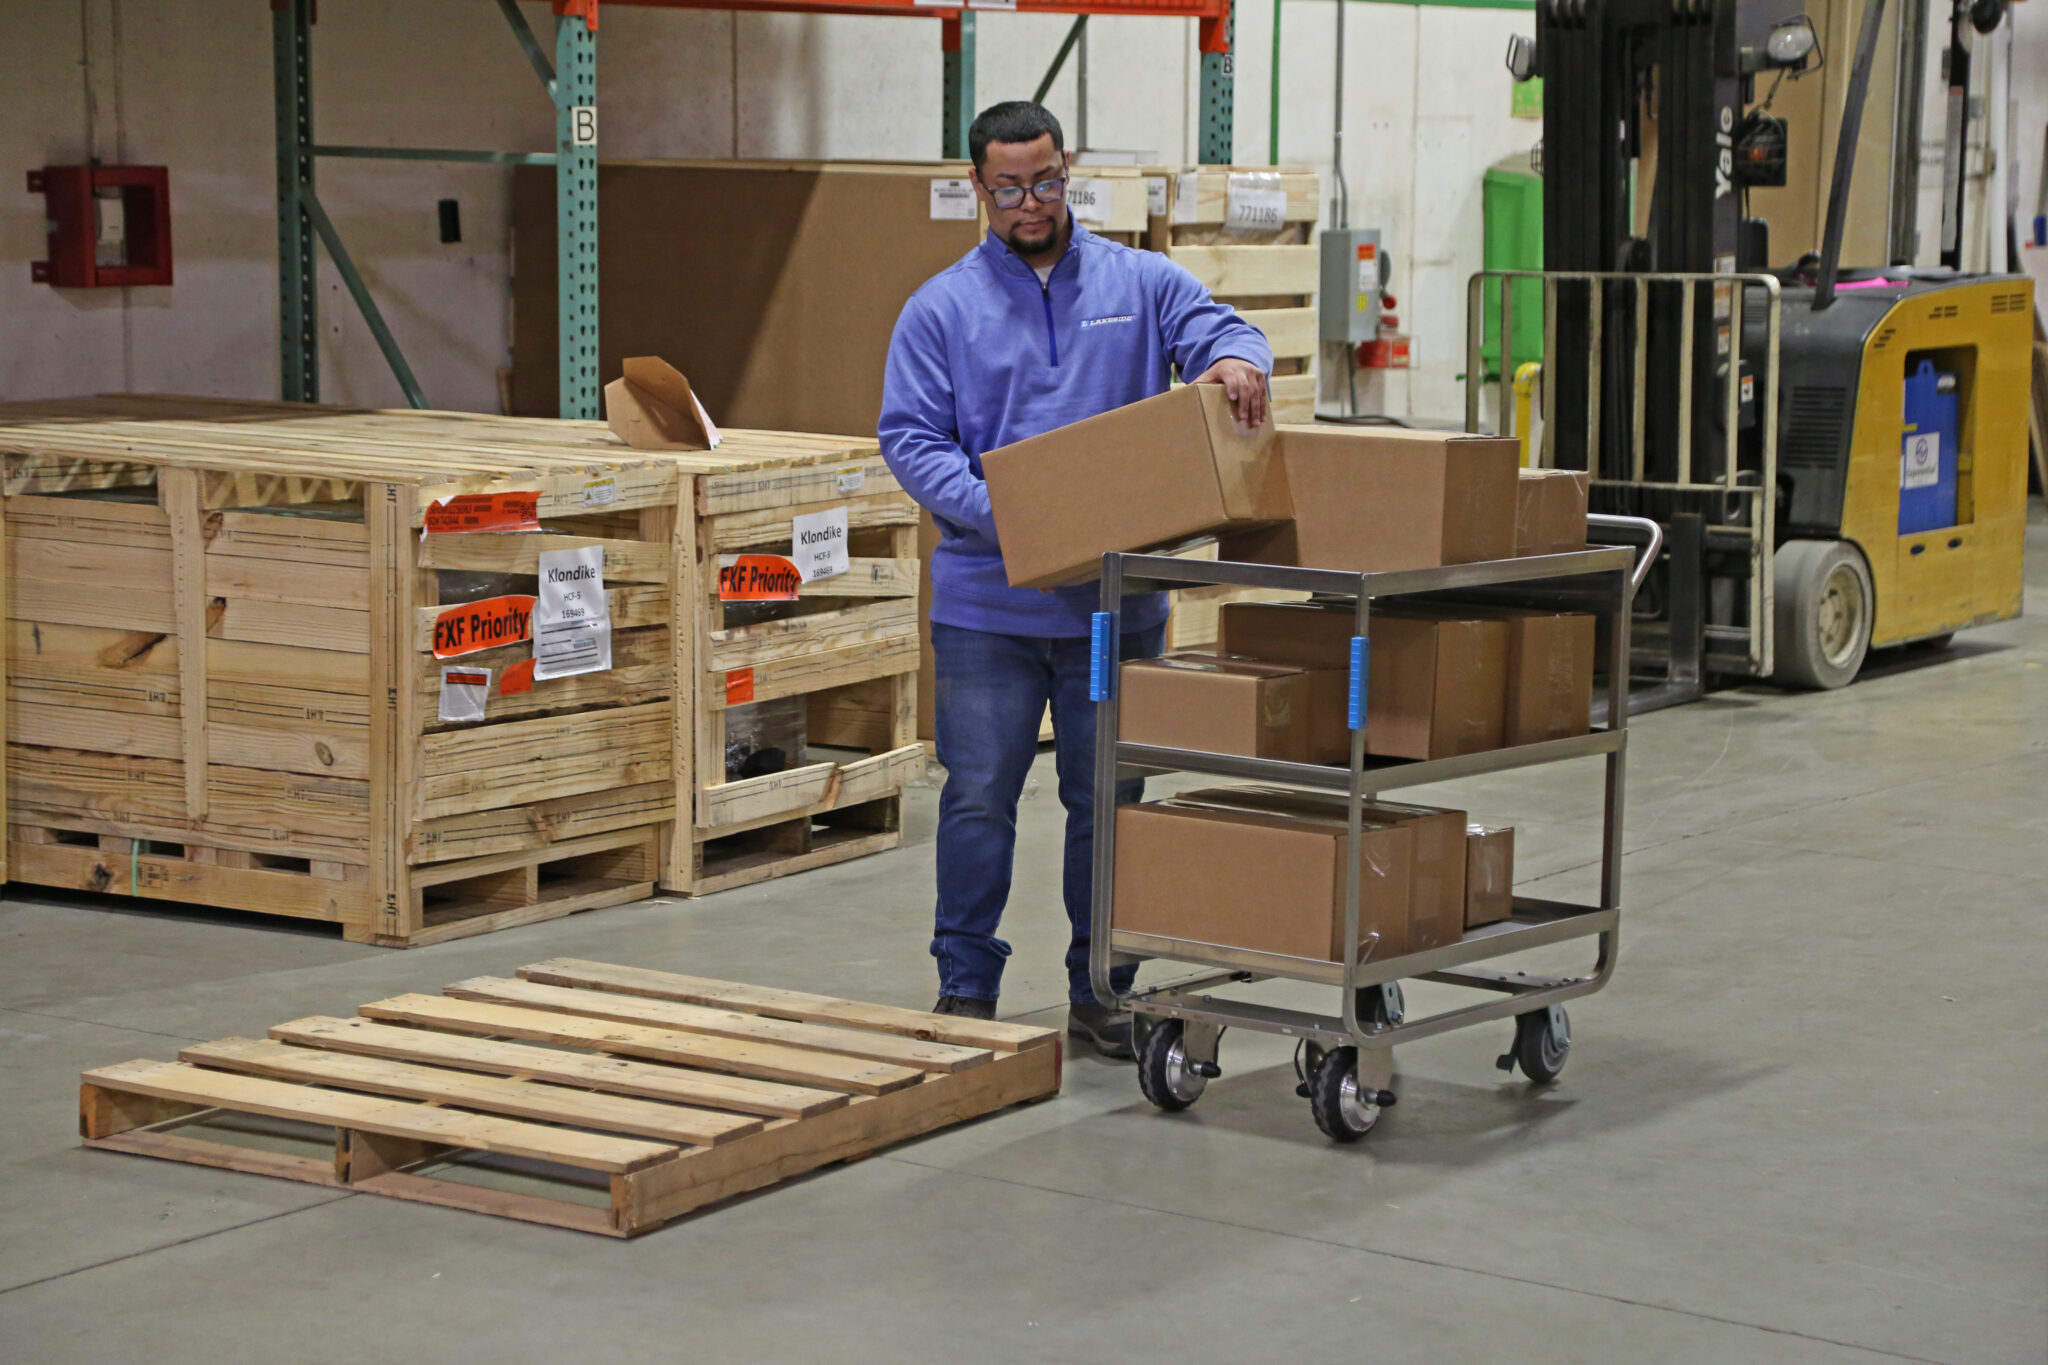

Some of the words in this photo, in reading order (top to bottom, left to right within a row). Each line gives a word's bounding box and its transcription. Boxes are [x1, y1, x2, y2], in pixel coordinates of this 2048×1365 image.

[1223, 55, 1233, 74] B
[577, 110, 594, 141] B
[1715, 105, 1733, 200] Yale
[1066, 189, 1096, 205] 71186
[1238, 205, 1278, 224] 771186
[800, 525, 842, 545] Klondike
[547, 565, 596, 583] Klondike
[720, 565, 747, 593] FXF
[749, 564, 800, 593] Priority
[563, 591, 582, 601] HCF-5
[561, 607, 585, 619] 169469
[435, 615, 465, 650] FXF
[471, 607, 529, 642] Priority
